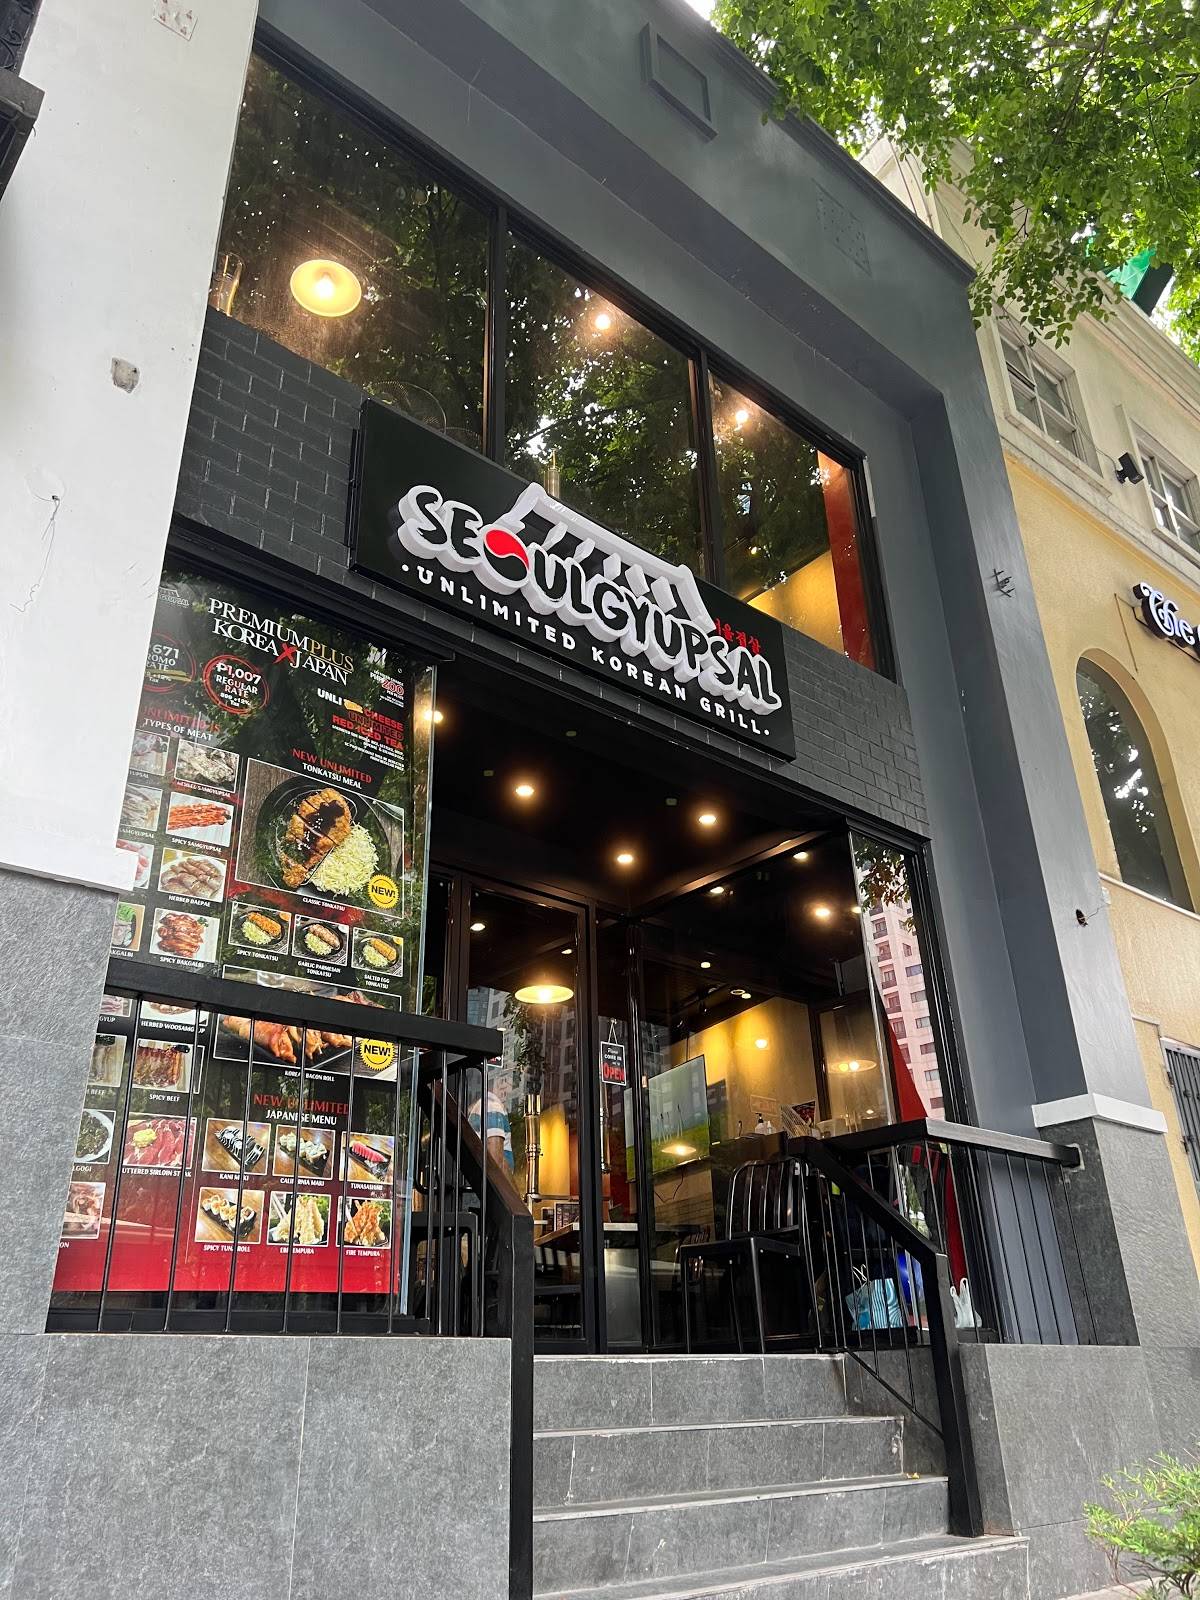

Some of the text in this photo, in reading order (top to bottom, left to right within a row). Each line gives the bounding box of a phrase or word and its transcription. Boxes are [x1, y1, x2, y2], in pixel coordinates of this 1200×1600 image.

[399, 486, 782, 714] SEOULGYUPSAL
[416, 565, 577, 651] UNLIMITED
[591, 646, 687, 701] KOREAN
[212, 617, 279, 657] KOREA
[289, 650, 349, 687] JAPAN
[215, 674, 258, 695] REGULAR
[224, 684, 249, 698] RATE
[317, 687, 404, 732] UNLI CHEESE
[143, 718, 214, 741] TYPES OF MEAT
[332, 714, 354, 730] RED
[384, 735, 404, 751] TEA
[291, 748, 373, 783] NEW UNLIMITED
[302, 762, 363, 790] TONKATSU MEAL
[171, 837, 187, 845] SPICY
[371, 885, 397, 899] NEW!
[168, 894, 190, 904] HERBED
[302, 896, 346, 912] CLASSIC TONKATSU
[160, 956, 176, 964] SPICY
[236, 949, 279, 962] SPICY TONKATSU
[297, 960, 341, 974] GARLIC PARMESAN
[306, 968, 332, 978] TONKATSU
[364, 973, 390, 984] SALTED EGG
[365, 980, 389, 990] TONKATSU
[141, 1021, 164, 1030] HERBED
[363, 1044, 391, 1057] NEW!
[284, 1069, 335, 1083] KOREA BACON ROLL
[603, 1062, 625, 1082] OPEN
[149, 1093, 166, 1101] SPICY
[253, 1093, 350, 1115] NEW ULIMITED
[311, 1114, 337, 1126] MENU
[121, 1167, 192, 1178] UTTERED SIRLOIN STAK
[219, 1173, 234, 1181] KANI
[280, 1177, 311, 1186] CALIFRNIA
[203, 1244, 220, 1252] SPICY
[237, 1245, 251, 1253] ROLL
[292, 1247, 315, 1255] EMPURA
[357, 1250, 381, 1258] TEMPURA
